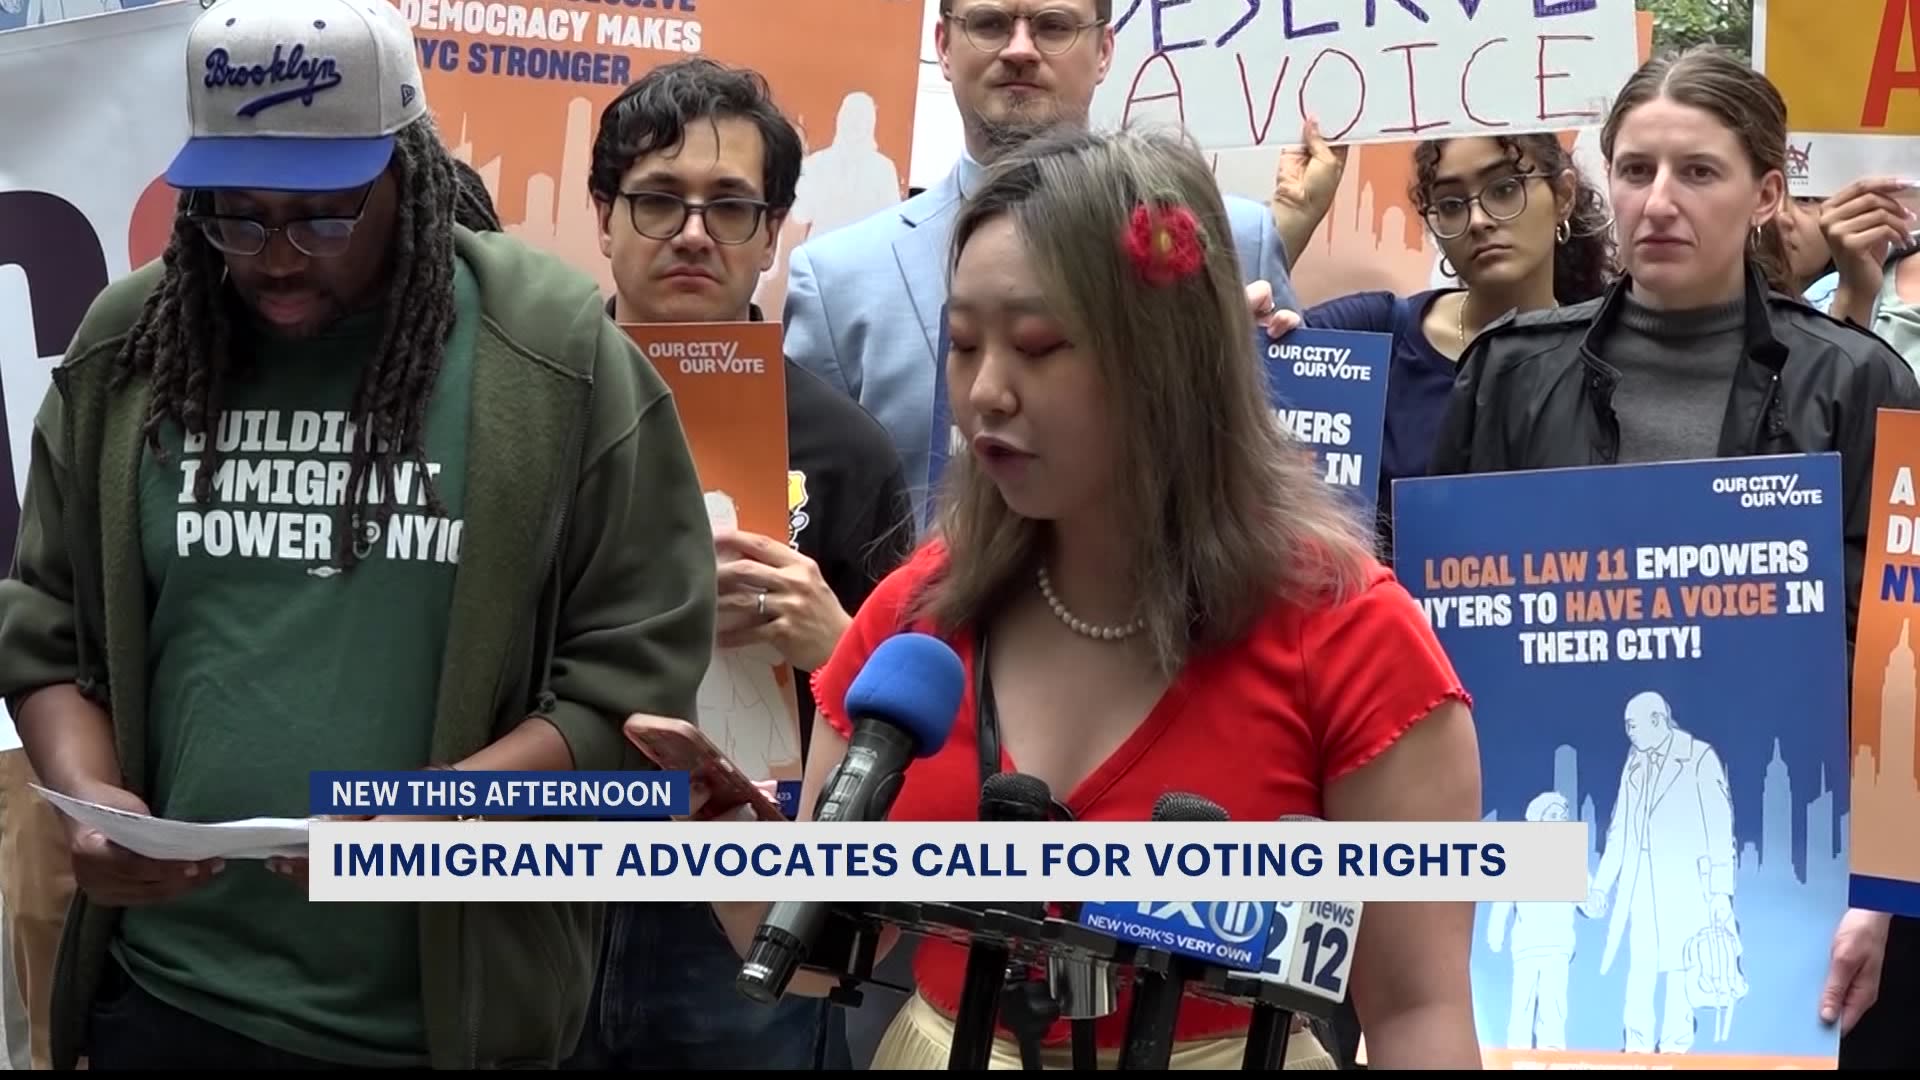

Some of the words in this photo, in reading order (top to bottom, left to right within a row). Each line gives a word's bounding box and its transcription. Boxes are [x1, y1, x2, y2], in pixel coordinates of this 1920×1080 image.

[597, 14, 703, 53] MAKES
[204, 43, 342, 117] Brooklyn
[415, 38, 460, 72] YC
[468, 43, 632, 86] STRONGER
[1122, 52, 1186, 143] A
[1236, 36, 1600, 145] VOICE
[649, 342, 686, 358] OUR
[687, 341, 733, 358] CITY
[680, 358, 717, 374] OUR
[716, 351, 766, 374] VOTE
[1268, 344, 1302, 360] OUR
[1302, 345, 1345, 363] CITY
[1293, 361, 1328, 378] OUR
[1327, 356, 1372, 381] VOTE
[1324, 452, 1362, 486] IN
[1712, 477, 1748, 493] OUR
[1748, 474, 1791, 491] CITY
[1889, 467, 1916, 506] A
[1741, 492, 1776, 508] OUR
[1776, 482, 1823, 506] VOTE
[177, 510, 333, 560] POWER
[1425, 554, 1516, 590] LOCAL
[1523, 551, 1589, 586] LAW
[1596, 549, 1629, 582] 11
[1636, 540, 1809, 580] EMPOWERS
[1519, 591, 1557, 625] TO
[1565, 588, 1643, 623] HAVE
[1651, 586, 1673, 619] A
[1680, 583, 1777, 618] VOICE
[1786, 580, 1825, 614] IN
[1519, 629, 1609, 665] THEIR
[1616, 625, 1702, 662] CITY!
[1087, 914, 1124, 931] NEW
[1122, 922, 1175, 945] YORK'S
[1176, 934, 1215, 955] VERY
[1215, 944, 1253, 963] OWN
[1301, 921, 1349, 994] 12
